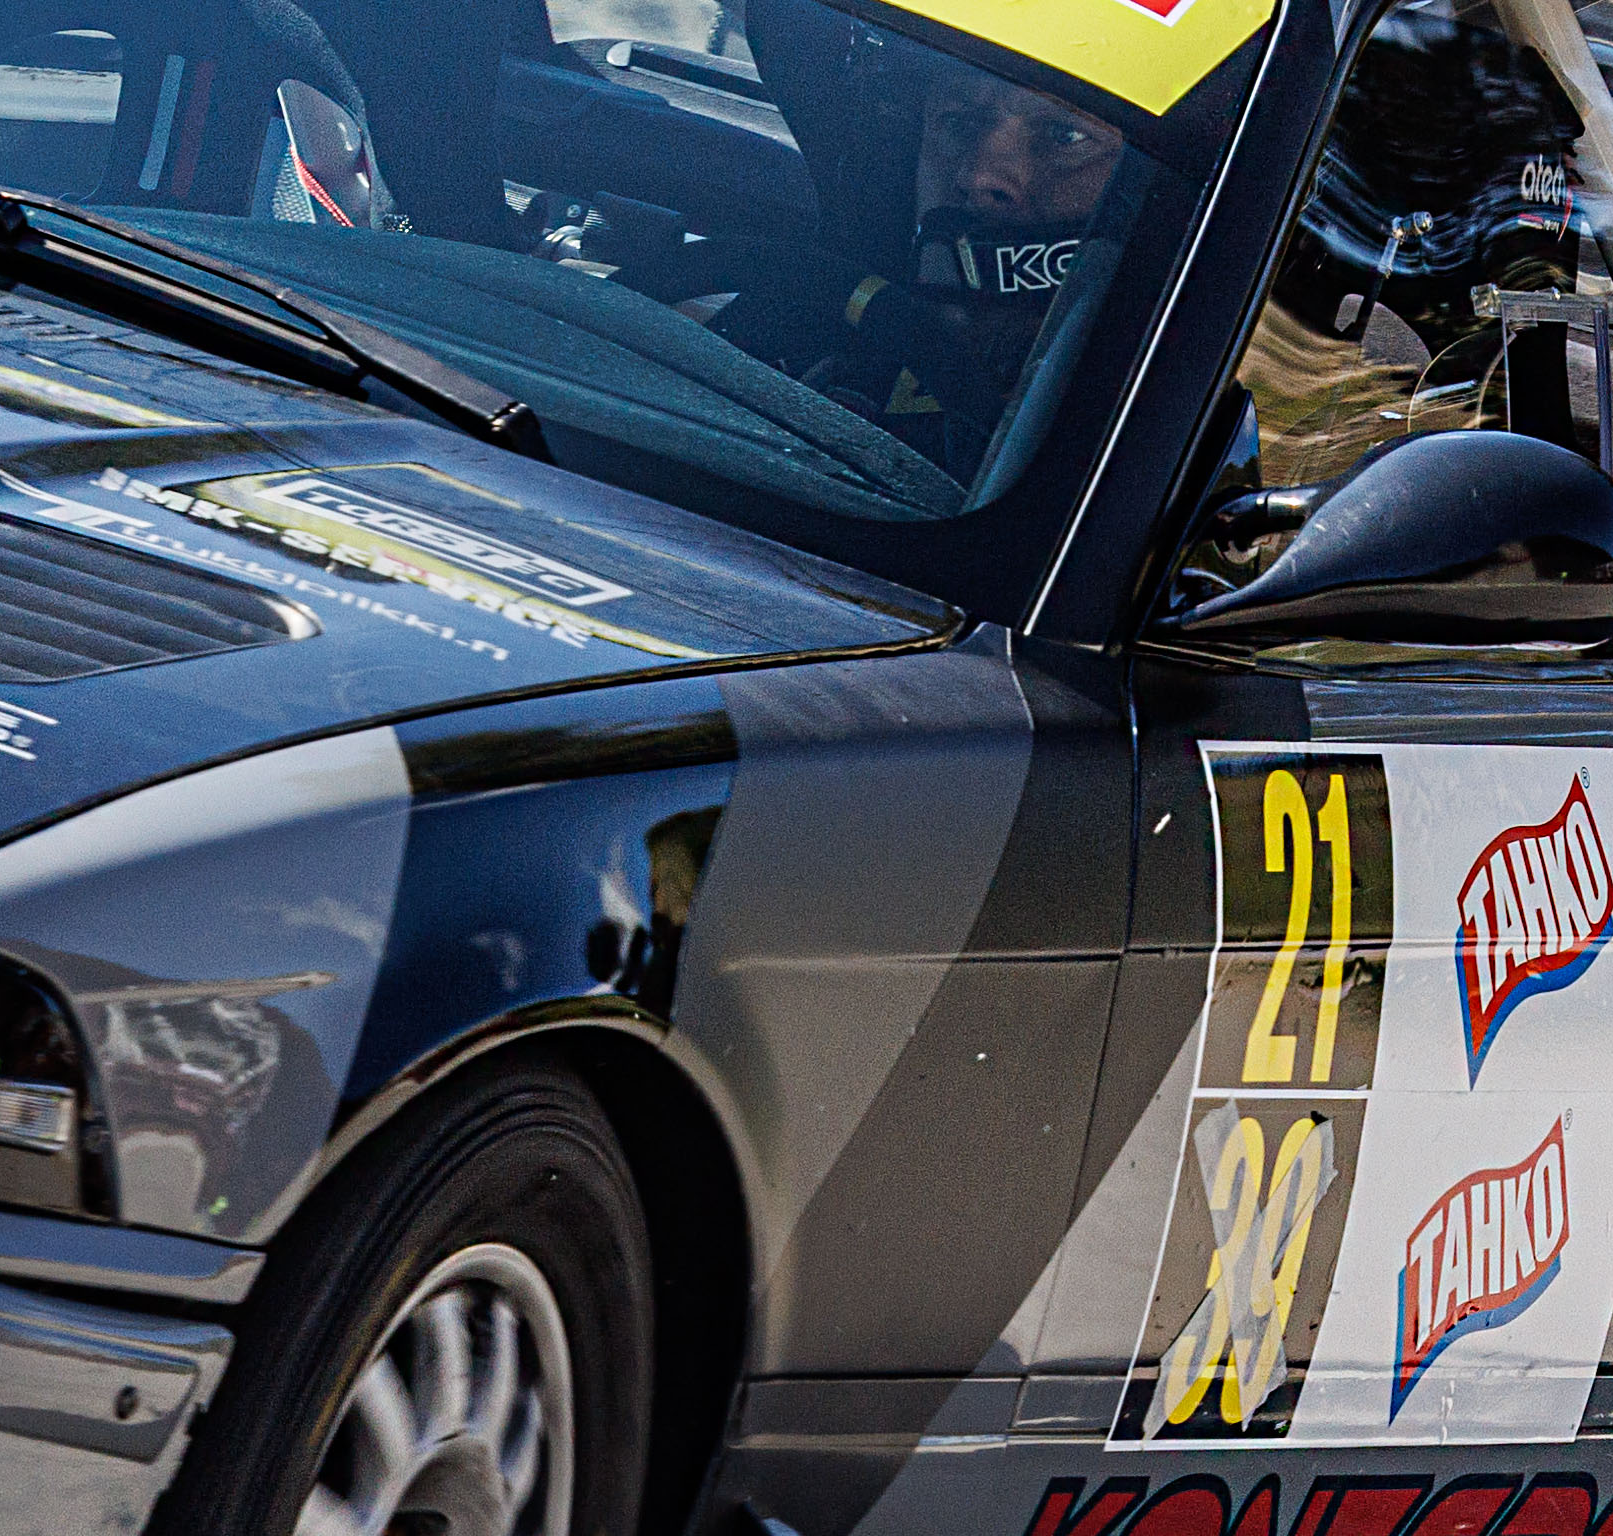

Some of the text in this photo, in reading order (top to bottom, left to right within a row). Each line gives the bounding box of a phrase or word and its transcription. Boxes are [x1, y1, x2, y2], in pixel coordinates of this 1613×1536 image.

[304, 490, 586, 592] TORSTEC
[1241, 769, 1354, 1083] 21
[1462, 800, 1609, 1015] TAHKO
[1410, 1143, 1565, 1354] TAHKO
